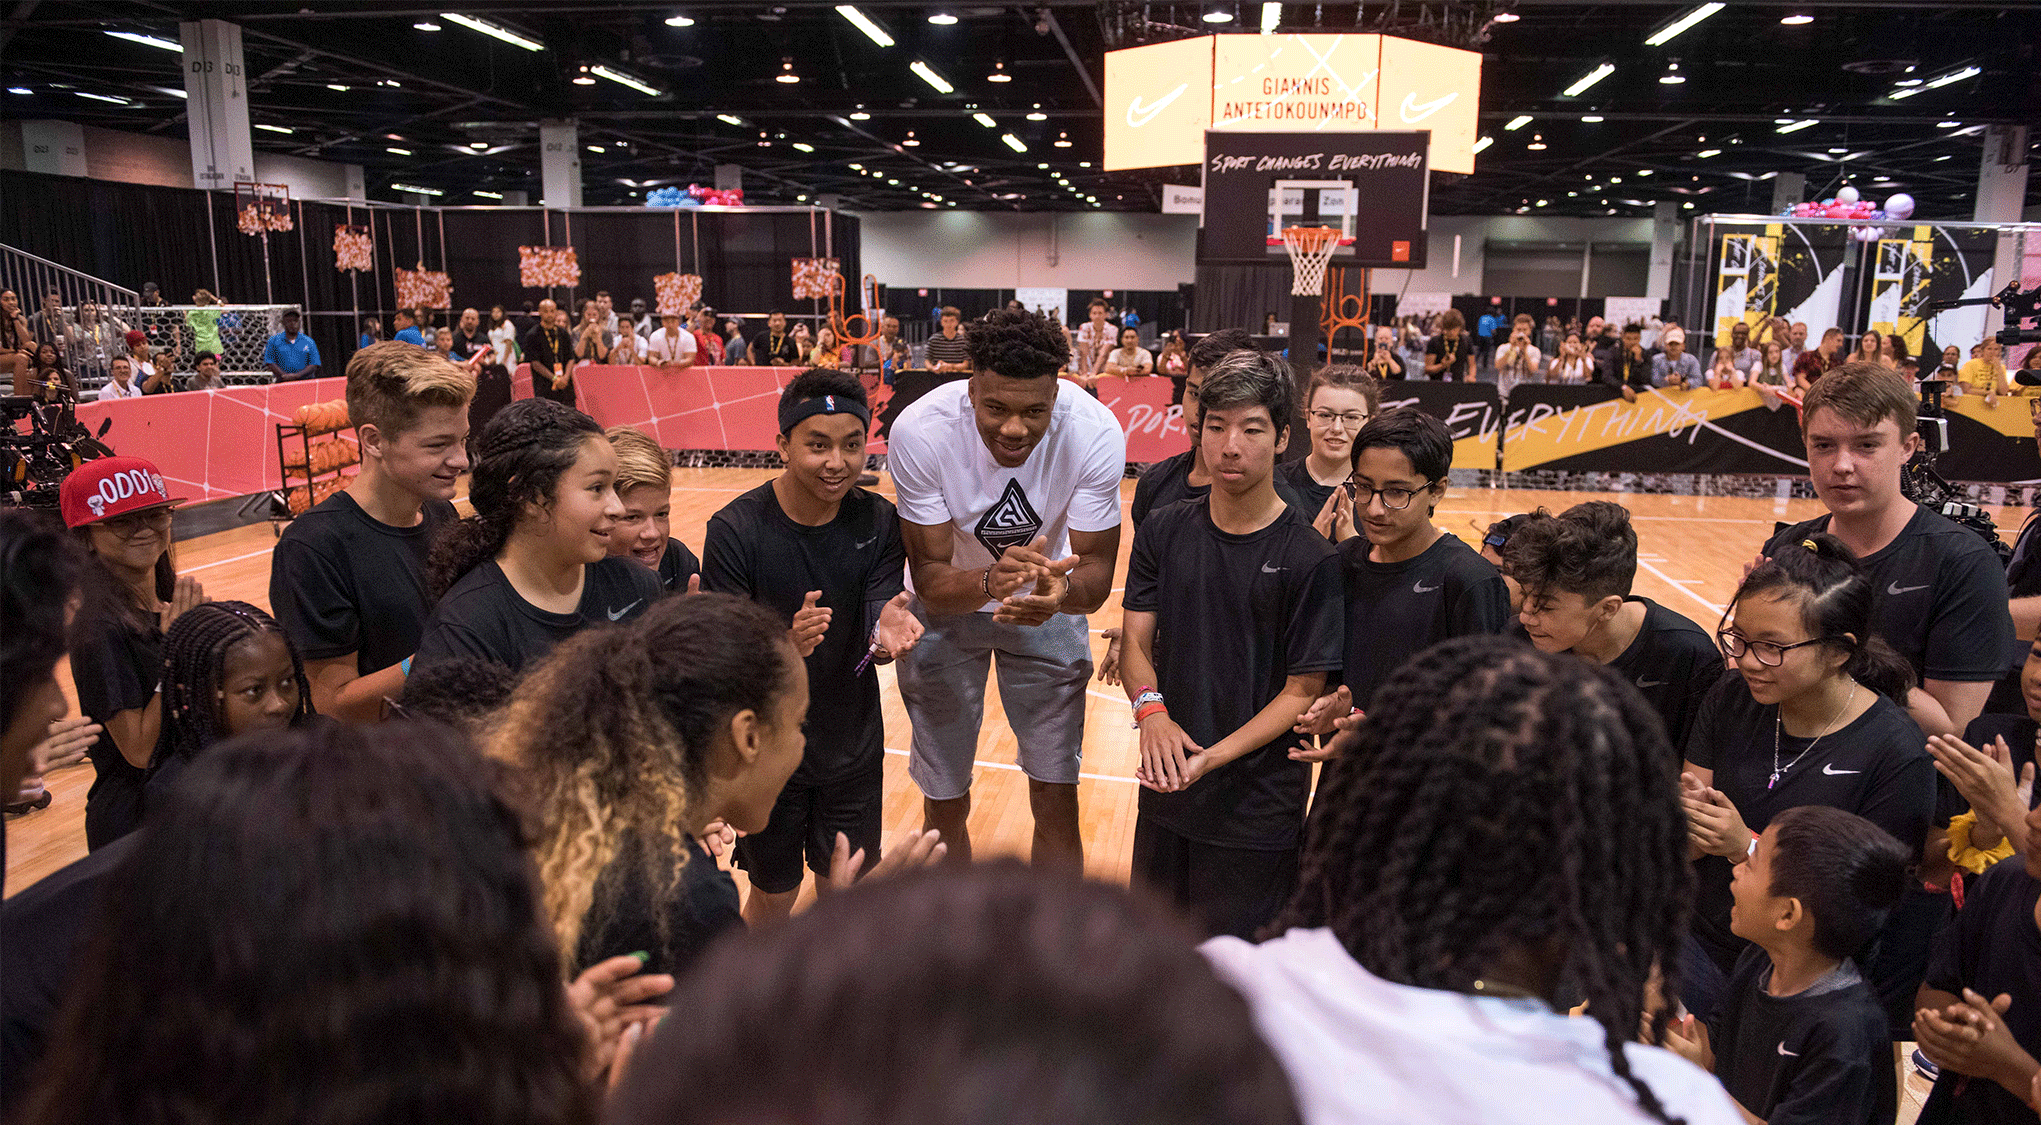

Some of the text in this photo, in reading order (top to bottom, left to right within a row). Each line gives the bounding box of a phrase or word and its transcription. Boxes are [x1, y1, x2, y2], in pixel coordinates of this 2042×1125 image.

[1263, 77, 1330, 95] GIANNIS
[1223, 101, 1367, 120] ANTETOKOUNMPO
[1211, 151, 1422, 174] SPORT CHANGES EVERYTHING
[1173, 194, 1203, 205] Bonu
[1322, 195, 1345, 206] Zon
[1106, 396, 1708, 446] POR EVERYTHING
